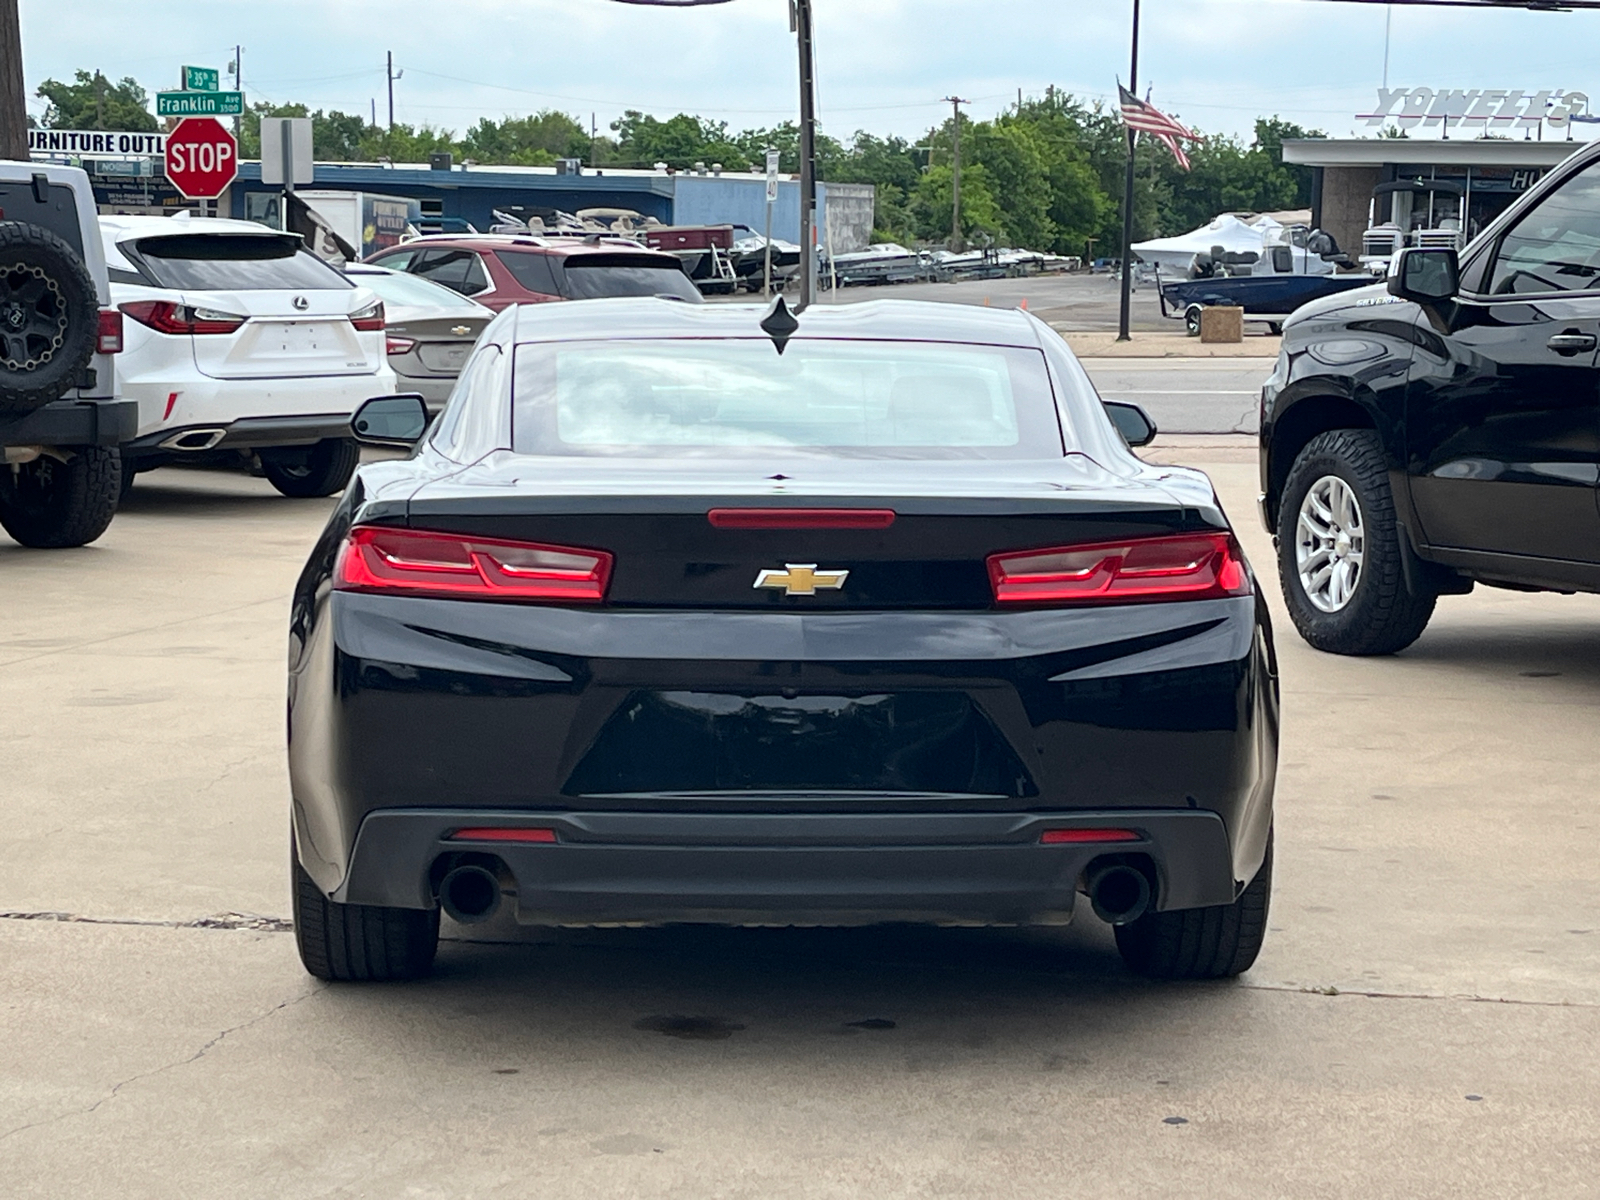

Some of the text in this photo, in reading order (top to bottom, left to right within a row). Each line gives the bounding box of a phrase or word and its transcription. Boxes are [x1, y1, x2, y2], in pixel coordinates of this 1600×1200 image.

[159, 95, 240, 113] Franklin Ave
[118, 134, 167, 154] OUTL
[170, 142, 232, 173] STOP
